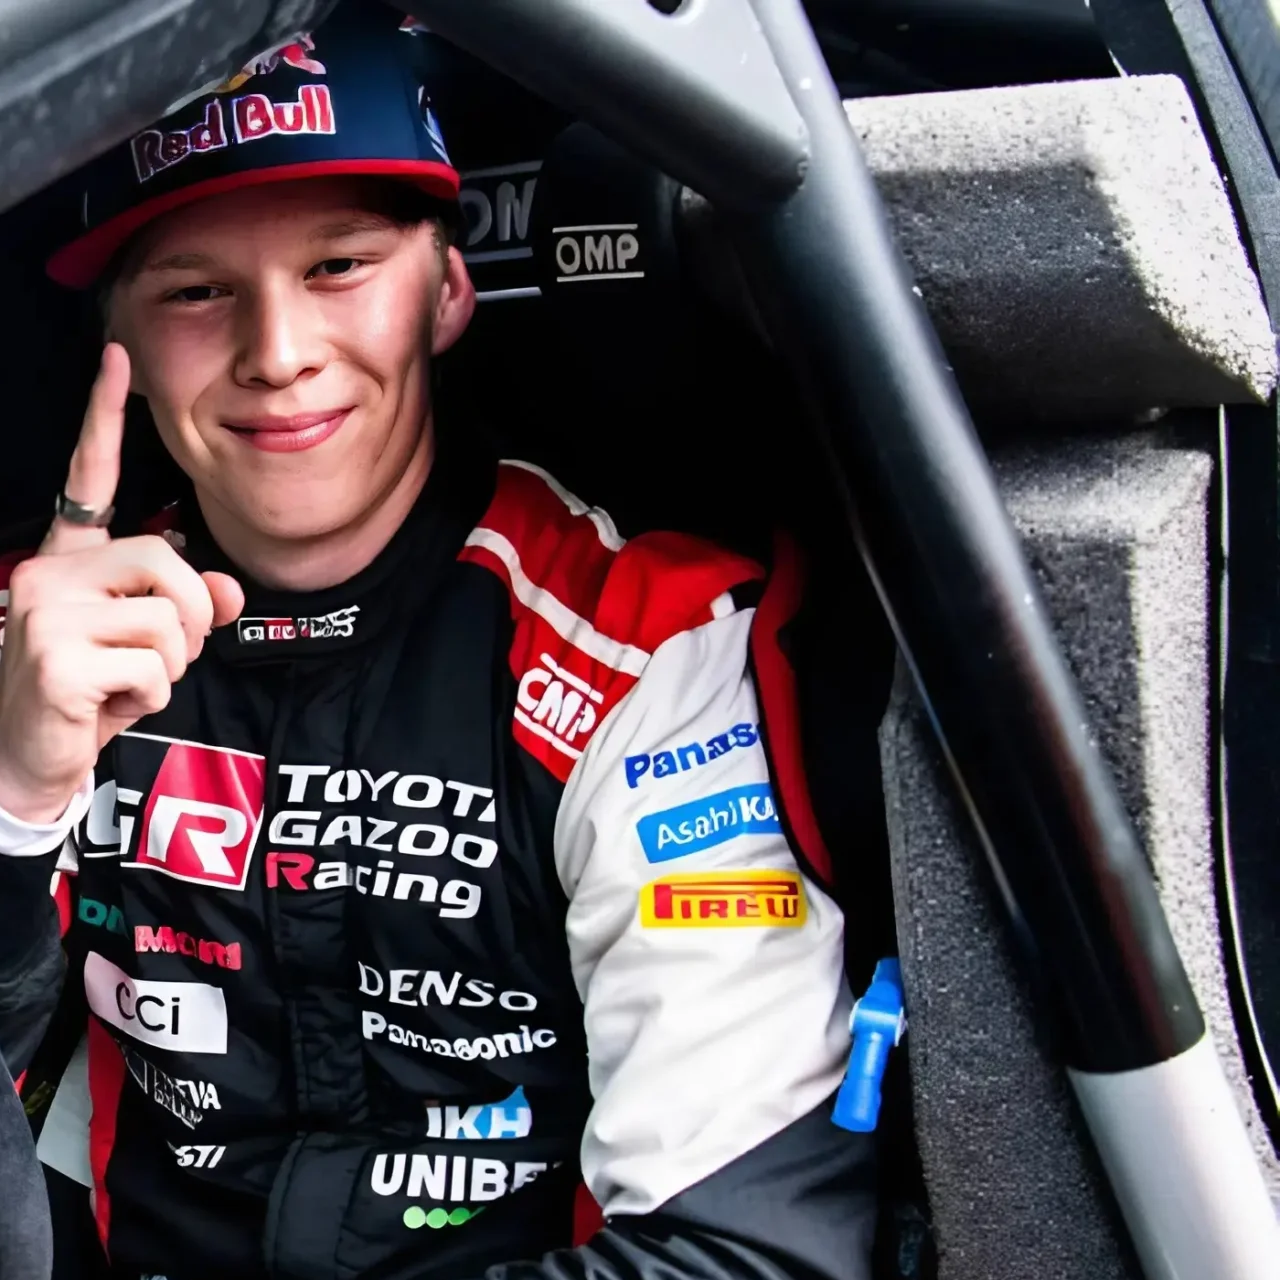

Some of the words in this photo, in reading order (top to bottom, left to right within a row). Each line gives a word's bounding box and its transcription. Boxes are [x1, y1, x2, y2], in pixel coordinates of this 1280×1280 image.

[131, 97, 228, 184] Red
[233, 84, 337, 144] Bull
[556, 233, 640, 275] OMP
[624, 722, 760, 789] Panas
[86, 779, 237, 878] GR
[268, 810, 499, 869] GAZOO
[265, 852, 482, 919] Racing
[358, 961, 538, 1011] DENSO
[362, 1010, 557, 1061] Panasonic
[426, 1105, 532, 1139] IKH
